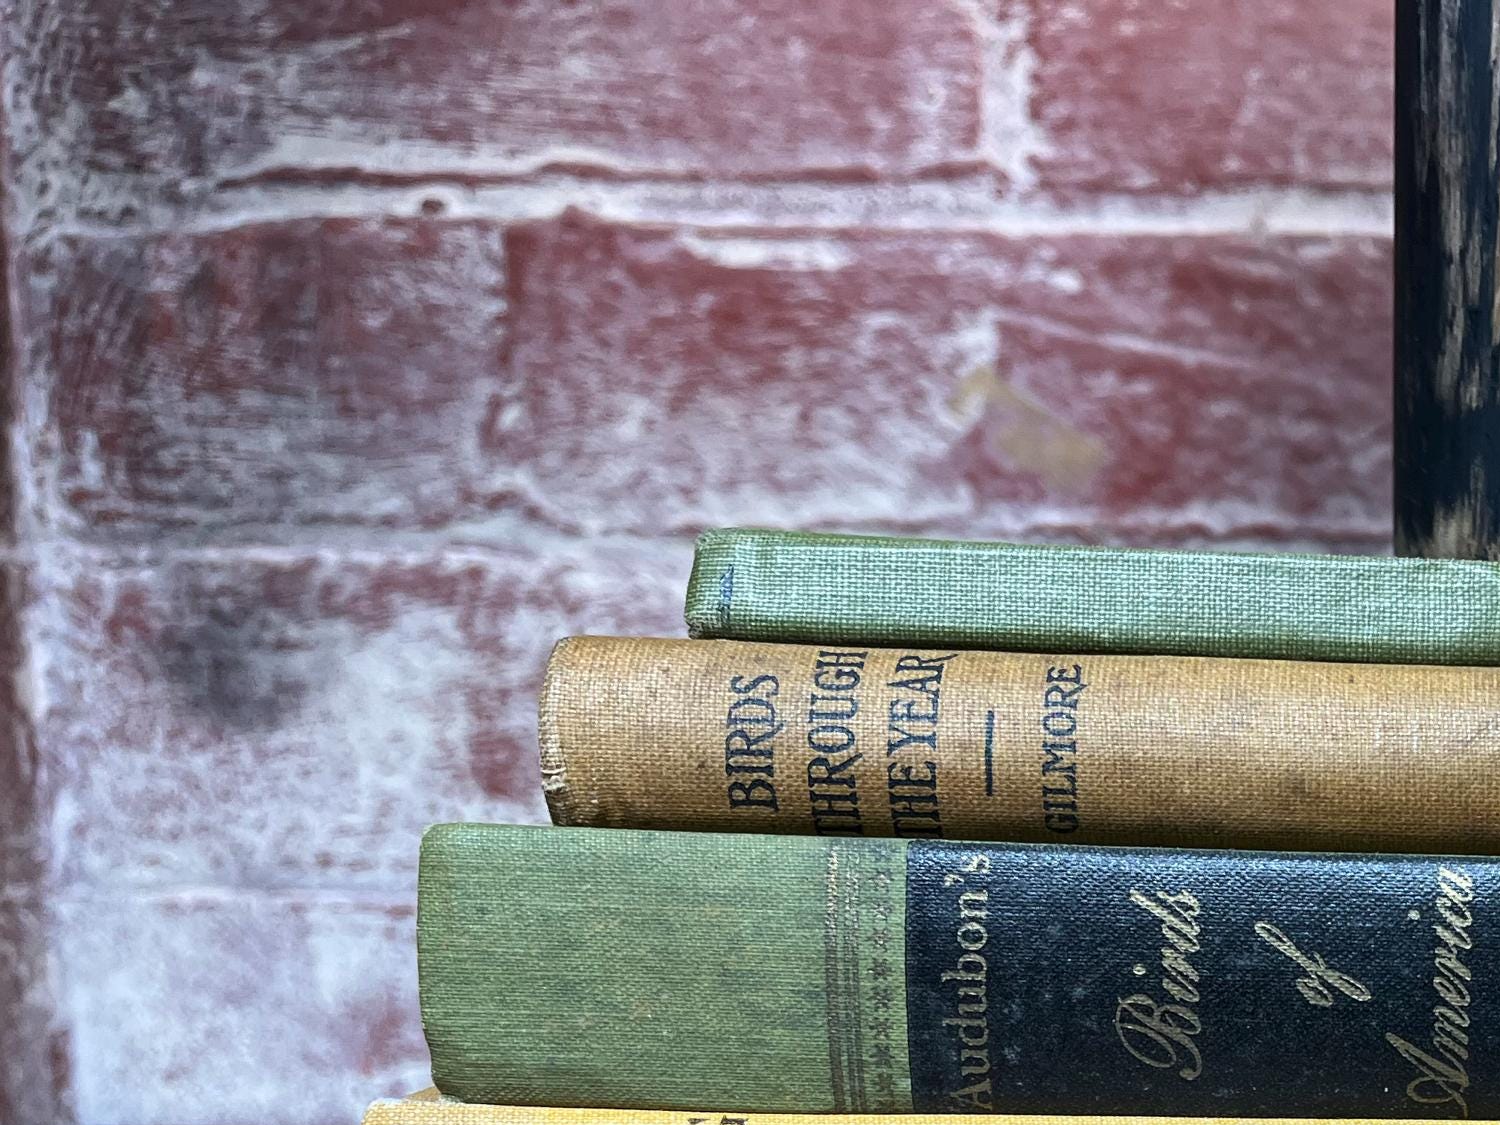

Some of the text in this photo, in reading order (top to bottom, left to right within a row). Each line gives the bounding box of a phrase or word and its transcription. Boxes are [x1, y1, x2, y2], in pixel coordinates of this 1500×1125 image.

[724, 674, 784, 812] BIRDS
[887, 652, 958, 758] YEAR
[1042, 663, 1088, 834] GILMORE
[941, 850, 992, 1112] Audubon's
[1114, 888, 1201, 1080] Birds
[1254, 921, 1372, 1008] of
[1386, 865, 1473, 1117] America
